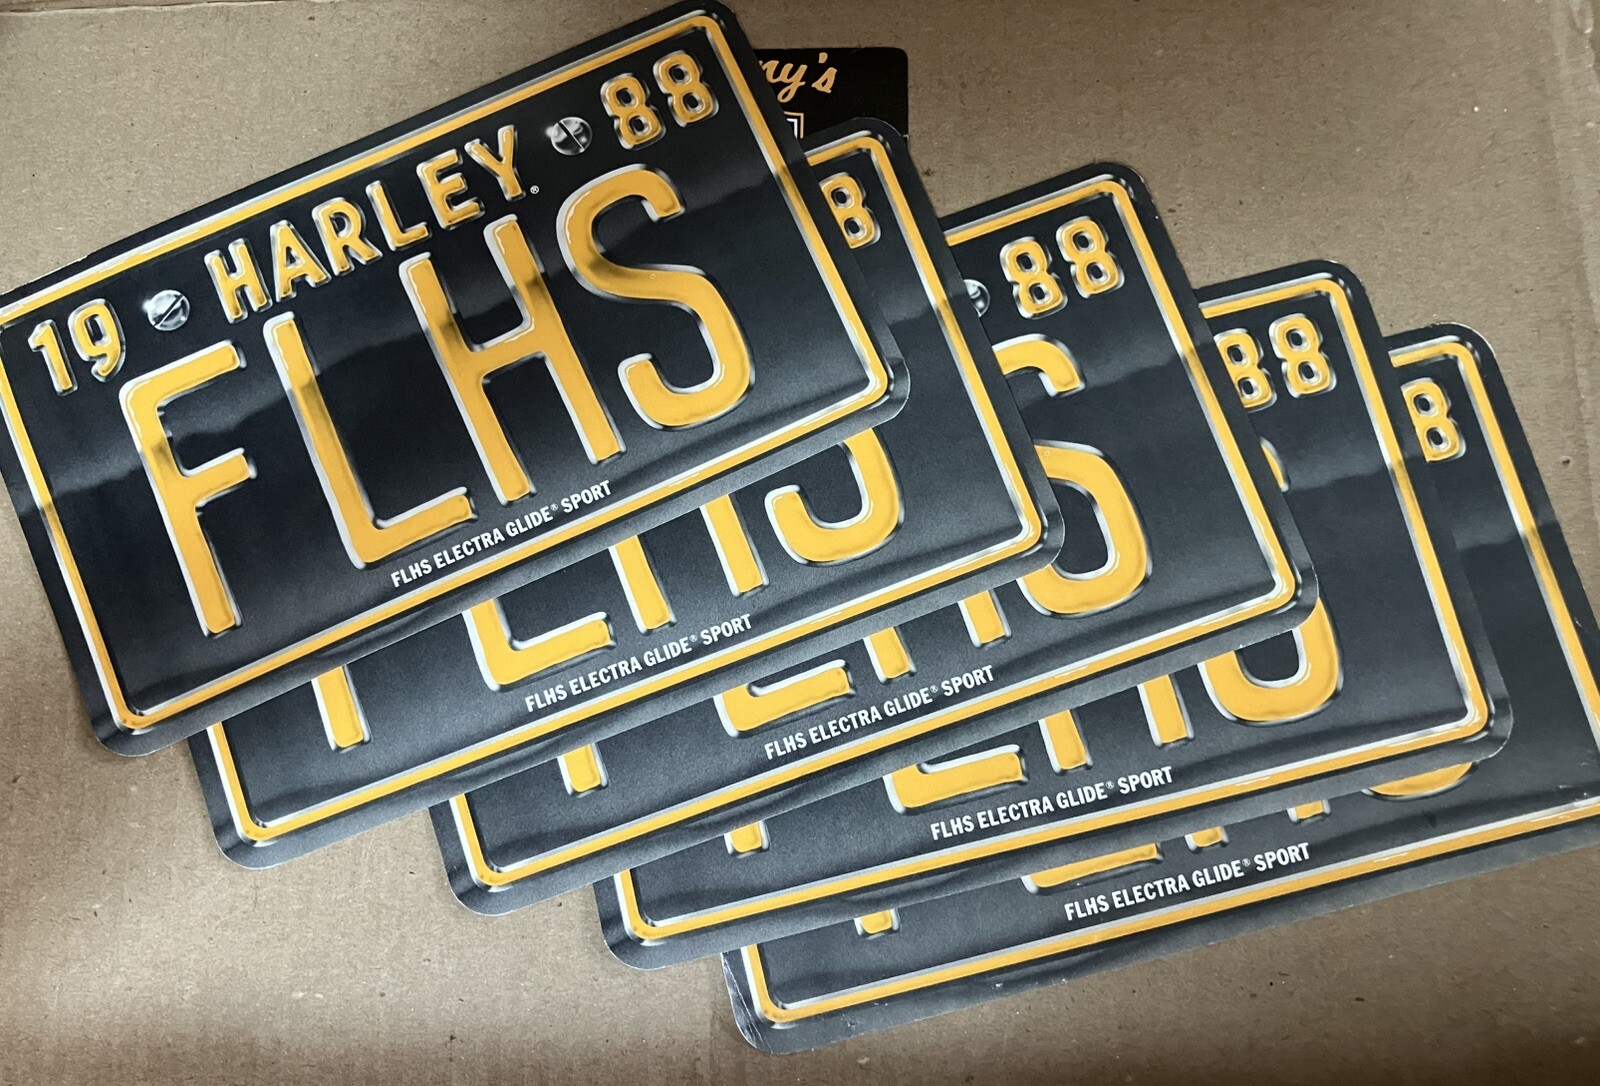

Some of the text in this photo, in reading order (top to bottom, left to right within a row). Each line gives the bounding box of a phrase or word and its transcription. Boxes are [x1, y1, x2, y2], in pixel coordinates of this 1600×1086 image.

[28, 298, 126, 395] 19
[600, 50, 719, 150] 88
[999, 216, 1125, 320] 88
[119, 164, 756, 638] FLHS
[1213, 313, 1337, 413] 88
[390, 559, 432, 588] FLHS
[433, 528, 505, 569] ELECTRA
[561, 480, 612, 513] SPORT
[524, 684, 568, 713] FLHS
[568, 656, 643, 696] ELECTRA
[700, 613, 752, 645] SPORT
[764, 732, 807, 760] FLHS
[808, 705, 883, 744] ELECTRA
[941, 665, 995, 697] SPORT
[930, 815, 975, 841] FLHS
[976, 796, 1055, 829] ELECTRA
[1117, 766, 1173, 794] SPORT
[1064, 894, 1110, 921] FLHS
[1111, 874, 1190, 909] ELECTRA
[1254, 842, 1310, 872] SPORT
